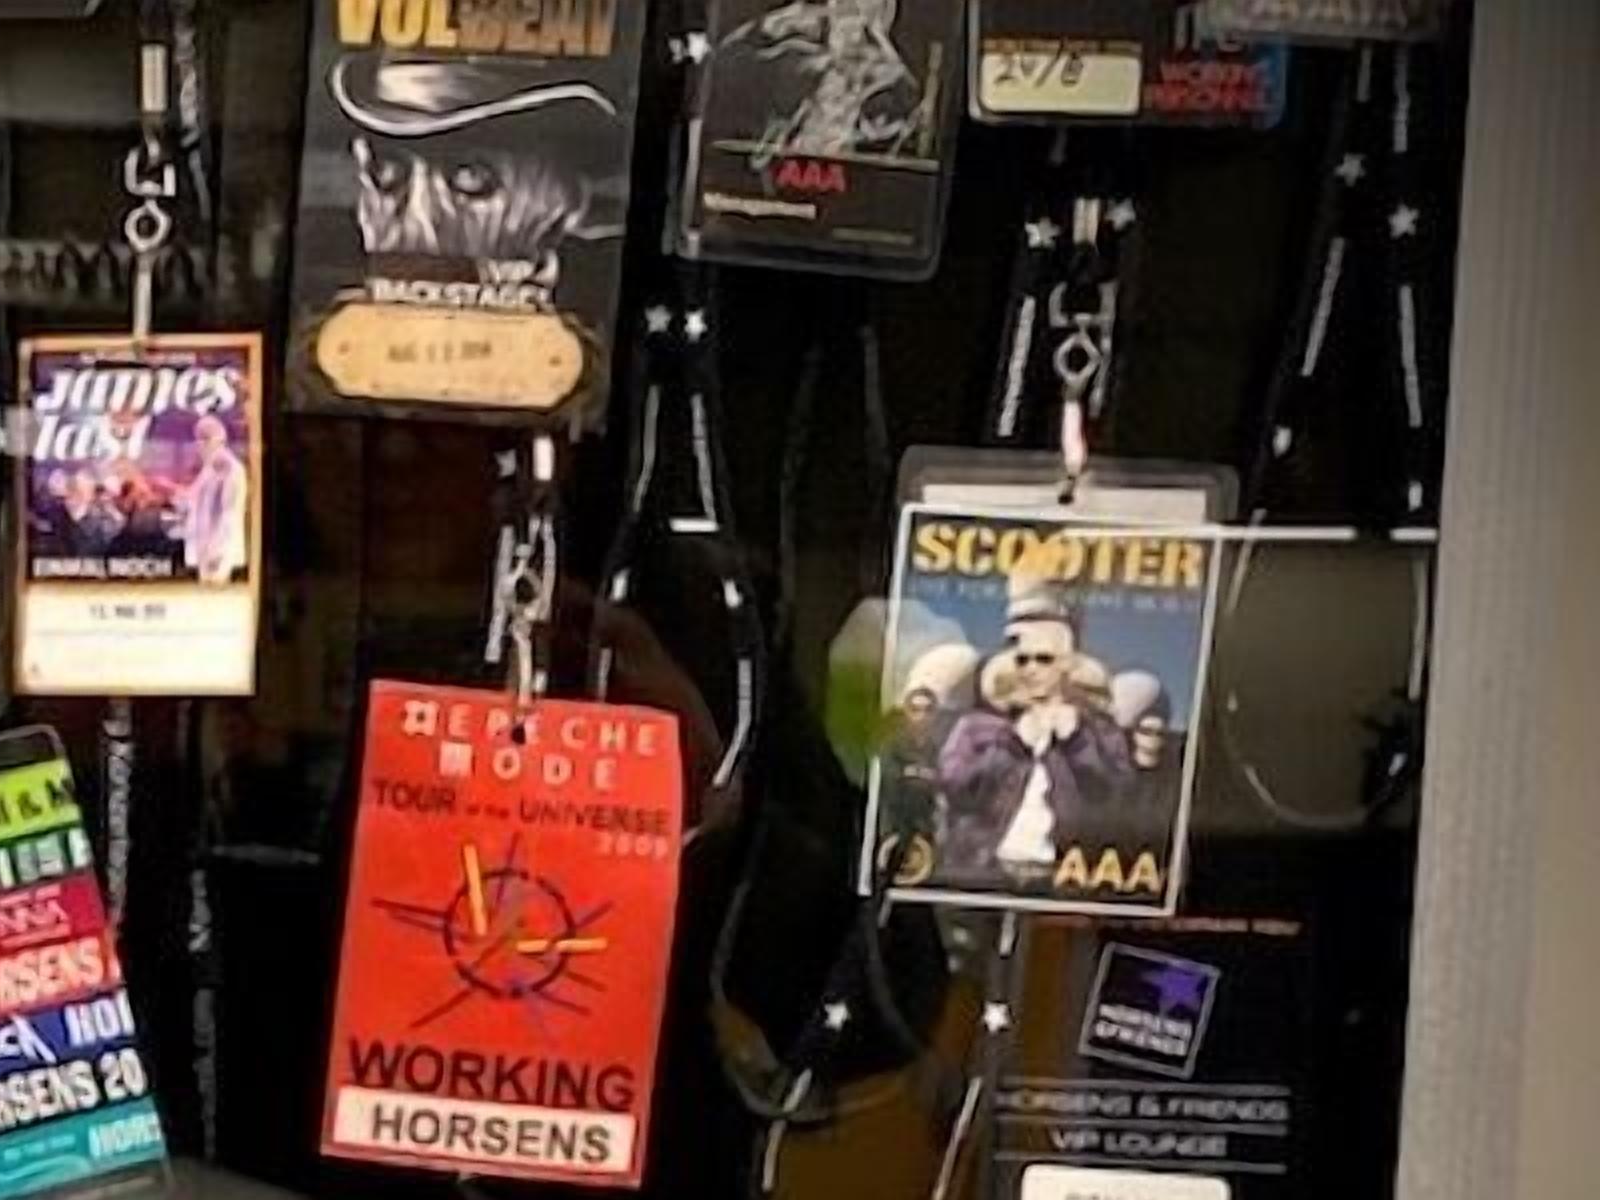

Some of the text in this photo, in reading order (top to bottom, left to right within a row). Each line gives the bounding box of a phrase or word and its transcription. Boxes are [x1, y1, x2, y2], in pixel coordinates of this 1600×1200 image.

[912, 521, 1205, 589] SCOOTER
[439, 739, 619, 791] MODE
[371, 779, 457, 815] TOUR
[518, 797, 672, 836] UNIVERSE
[1052, 845, 1164, 894] AAA
[347, 1036, 638, 1115] WORKING
[371, 1101, 613, 1164] HORSENS
